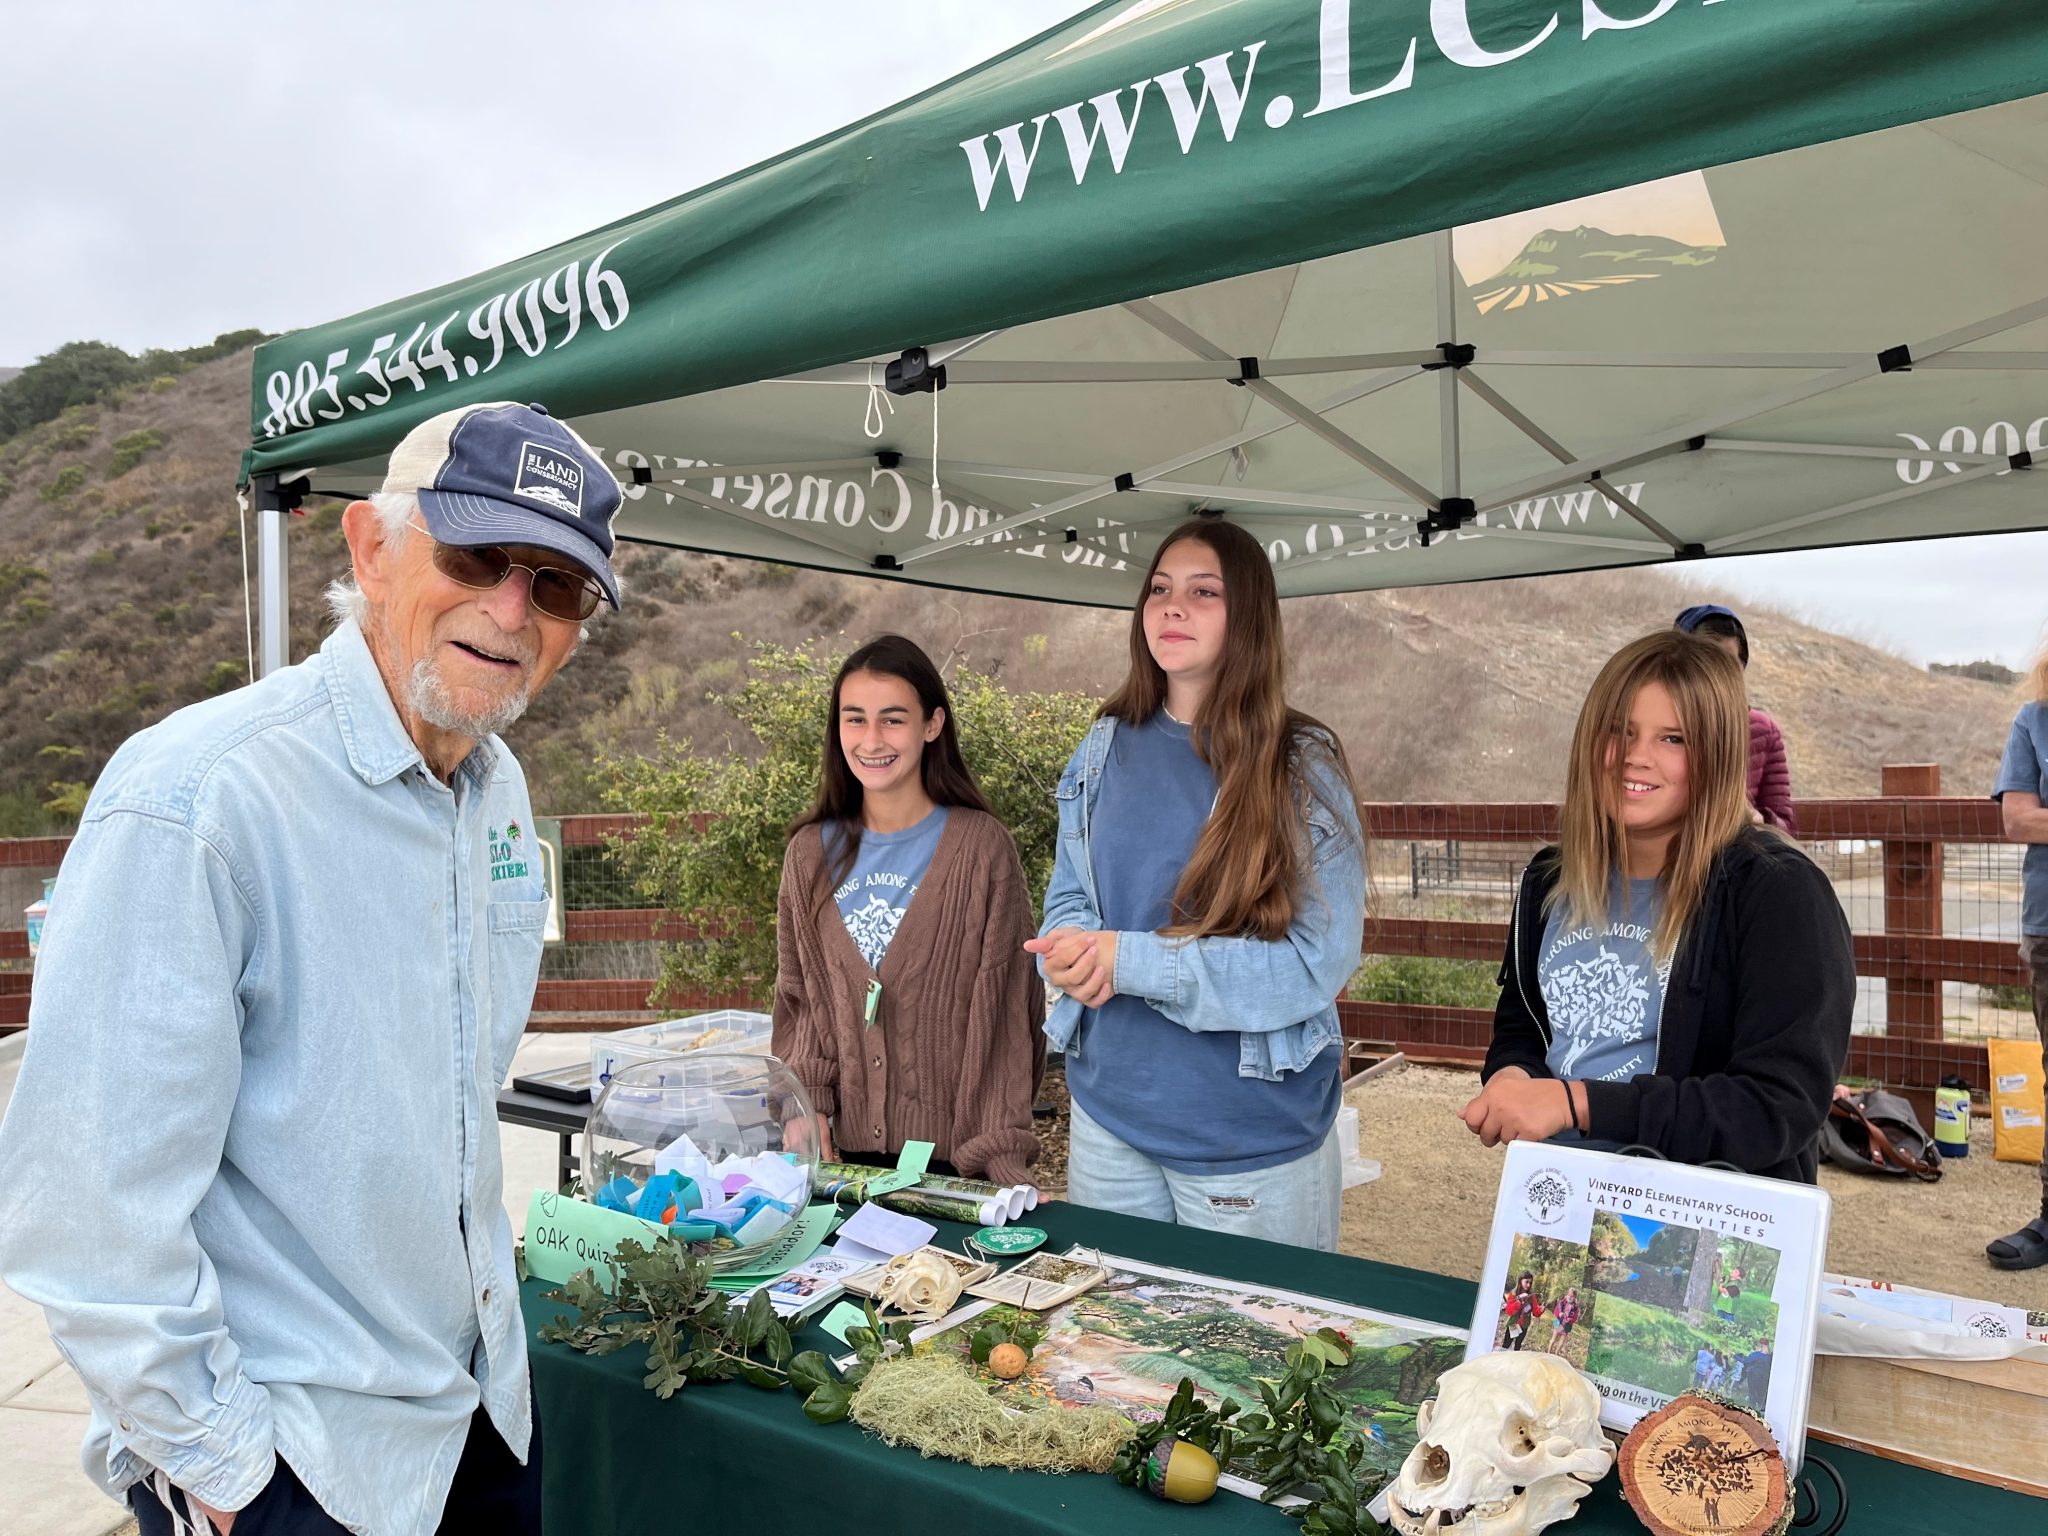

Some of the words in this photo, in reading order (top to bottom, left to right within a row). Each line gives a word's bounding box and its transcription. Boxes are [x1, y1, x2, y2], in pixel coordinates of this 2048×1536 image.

[959, 0, 1724, 212] www.LC
[262, 237, 630, 438] 805.544.9096
[526, 465, 578, 491] CONSERVANCY
[535, 456, 579, 483] LAND
[865, 872, 908, 889] AMONG
[1600, 922, 1651, 943] AMONG
[1597, 1055, 1643, 1081] OUNTY
[1588, 1177, 1643, 1198] VINEYARD
[1645, 1188, 1722, 1213] ELEMENTARY
[1725, 1204, 1775, 1224] SCHOOL
[1587, 1192, 1632, 1210] LATO
[1644, 1204, 1765, 1238] ACTIVITIES
[536, 1226, 570, 1252] OAK
[576, 1238, 611, 1264] Quiz
[1612, 1388, 1627, 1400] on
[1628, 1391, 1648, 1405] the
